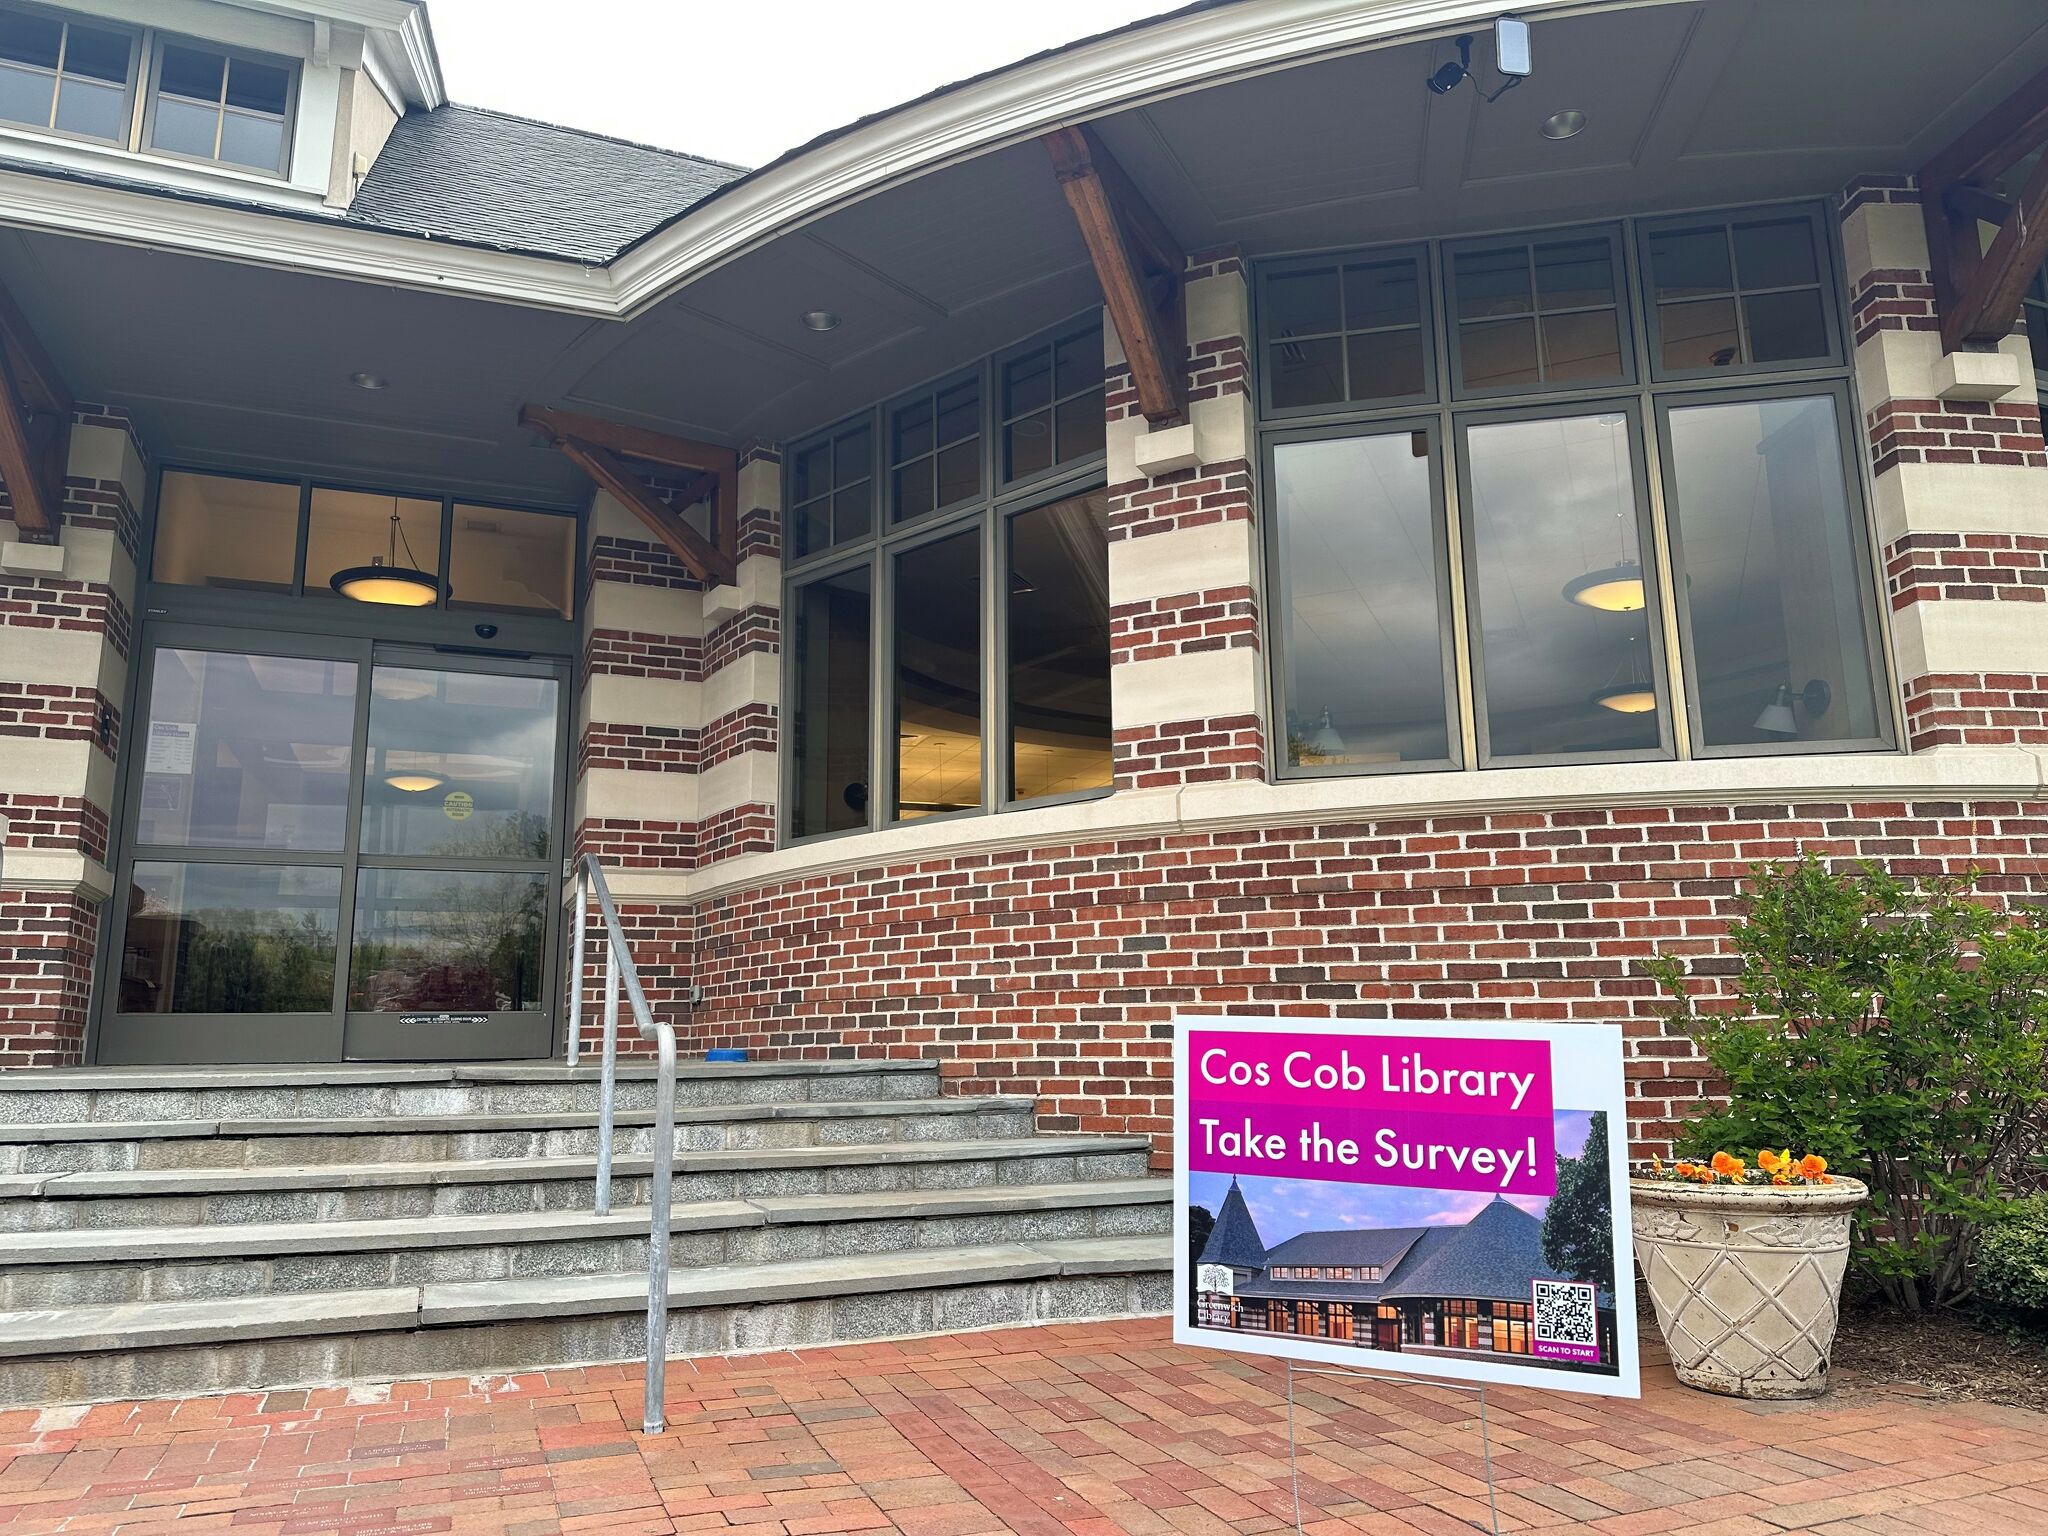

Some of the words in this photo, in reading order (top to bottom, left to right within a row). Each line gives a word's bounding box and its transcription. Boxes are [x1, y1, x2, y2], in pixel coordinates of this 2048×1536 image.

[1200, 1048, 1270, 1087] Cos
[1283, 1050, 1366, 1091] Cob
[1382, 1052, 1535, 1110] Library
[1199, 1117, 1286, 1160] Take
[1299, 1121, 1359, 1165] the
[1374, 1128, 1537, 1187] Survey!
[1197, 1297, 1244, 1313] Greenwich
[1198, 1309, 1229, 1325] Library
[1538, 1345, 1560, 1354] SCAN
[1561, 1347, 1571, 1355] TO
[1572, 1348, 1595, 1357] START
